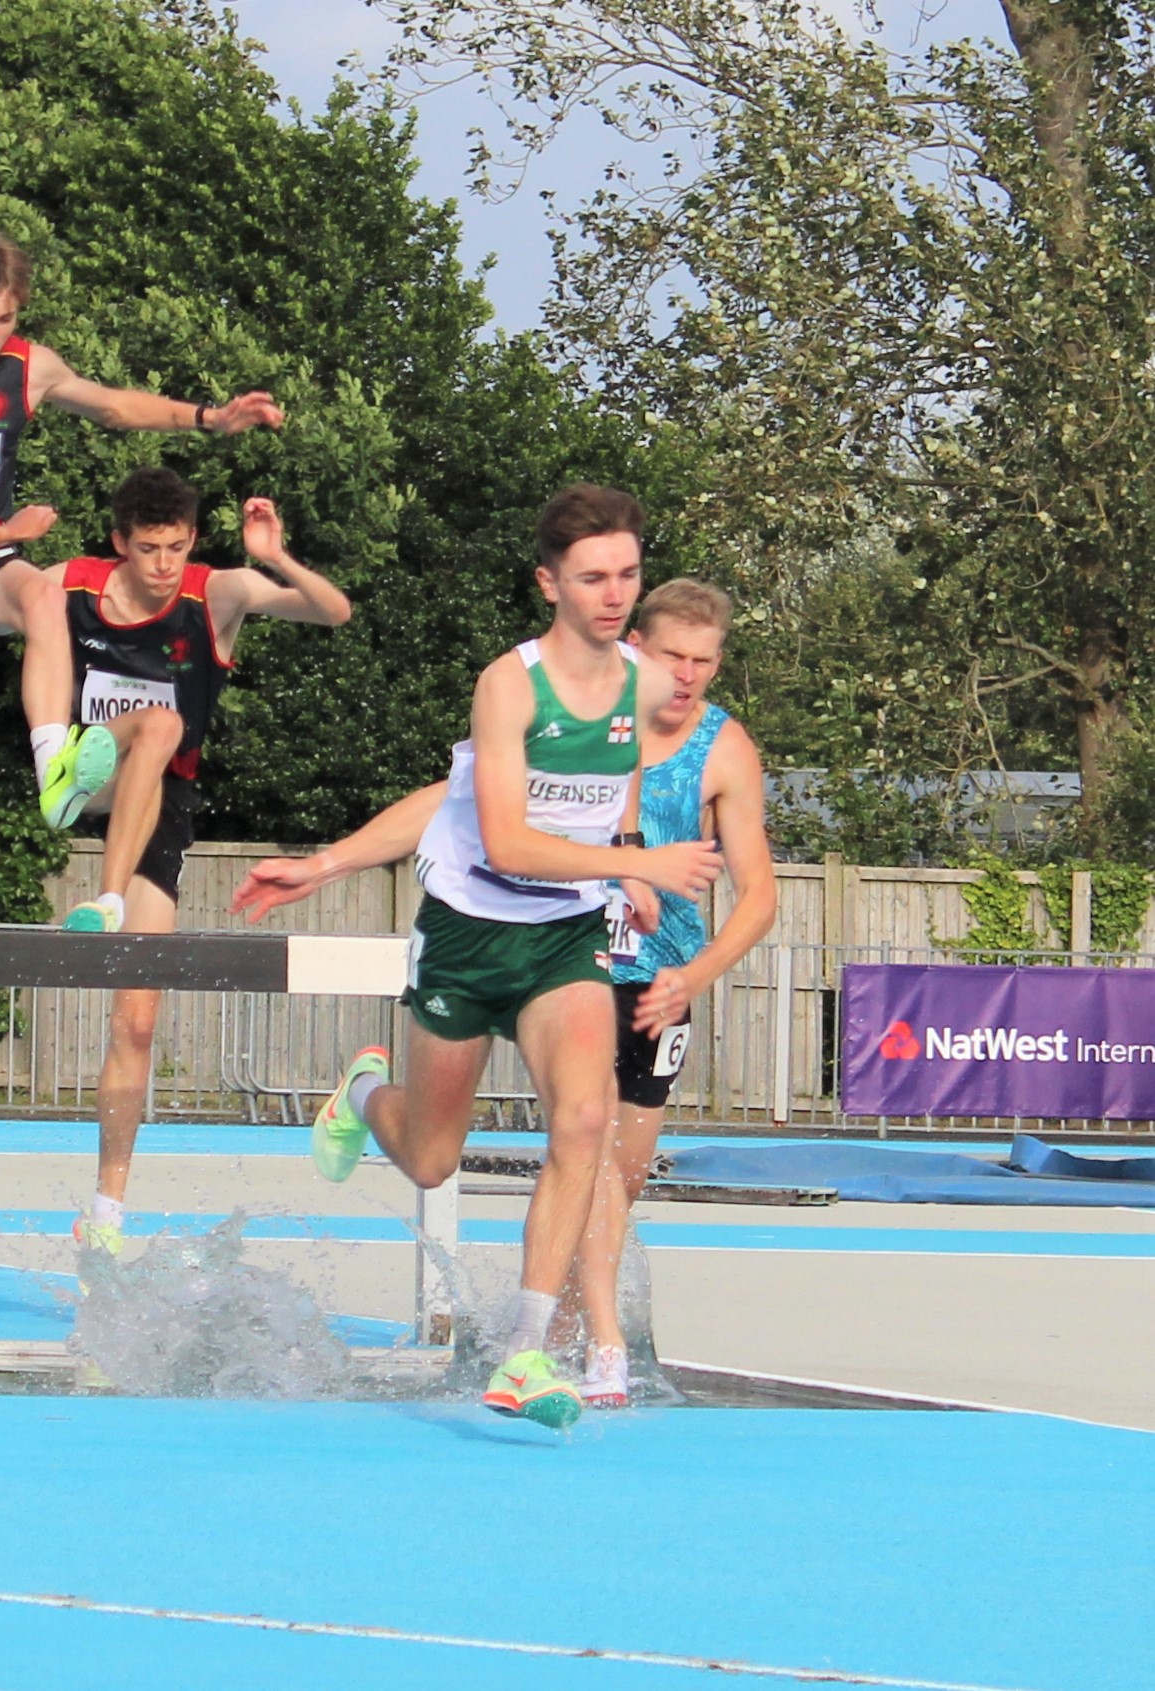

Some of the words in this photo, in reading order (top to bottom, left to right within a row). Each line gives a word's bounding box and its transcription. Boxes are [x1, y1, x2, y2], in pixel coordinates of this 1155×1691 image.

[89, 697, 171, 722] MOR
[527, 778, 620, 805] UERNSEY
[668, 1033, 684, 1067] 6
[925, 1027, 1069, 1062] NatWest
[1077, 1037, 1155, 1063] Intern
